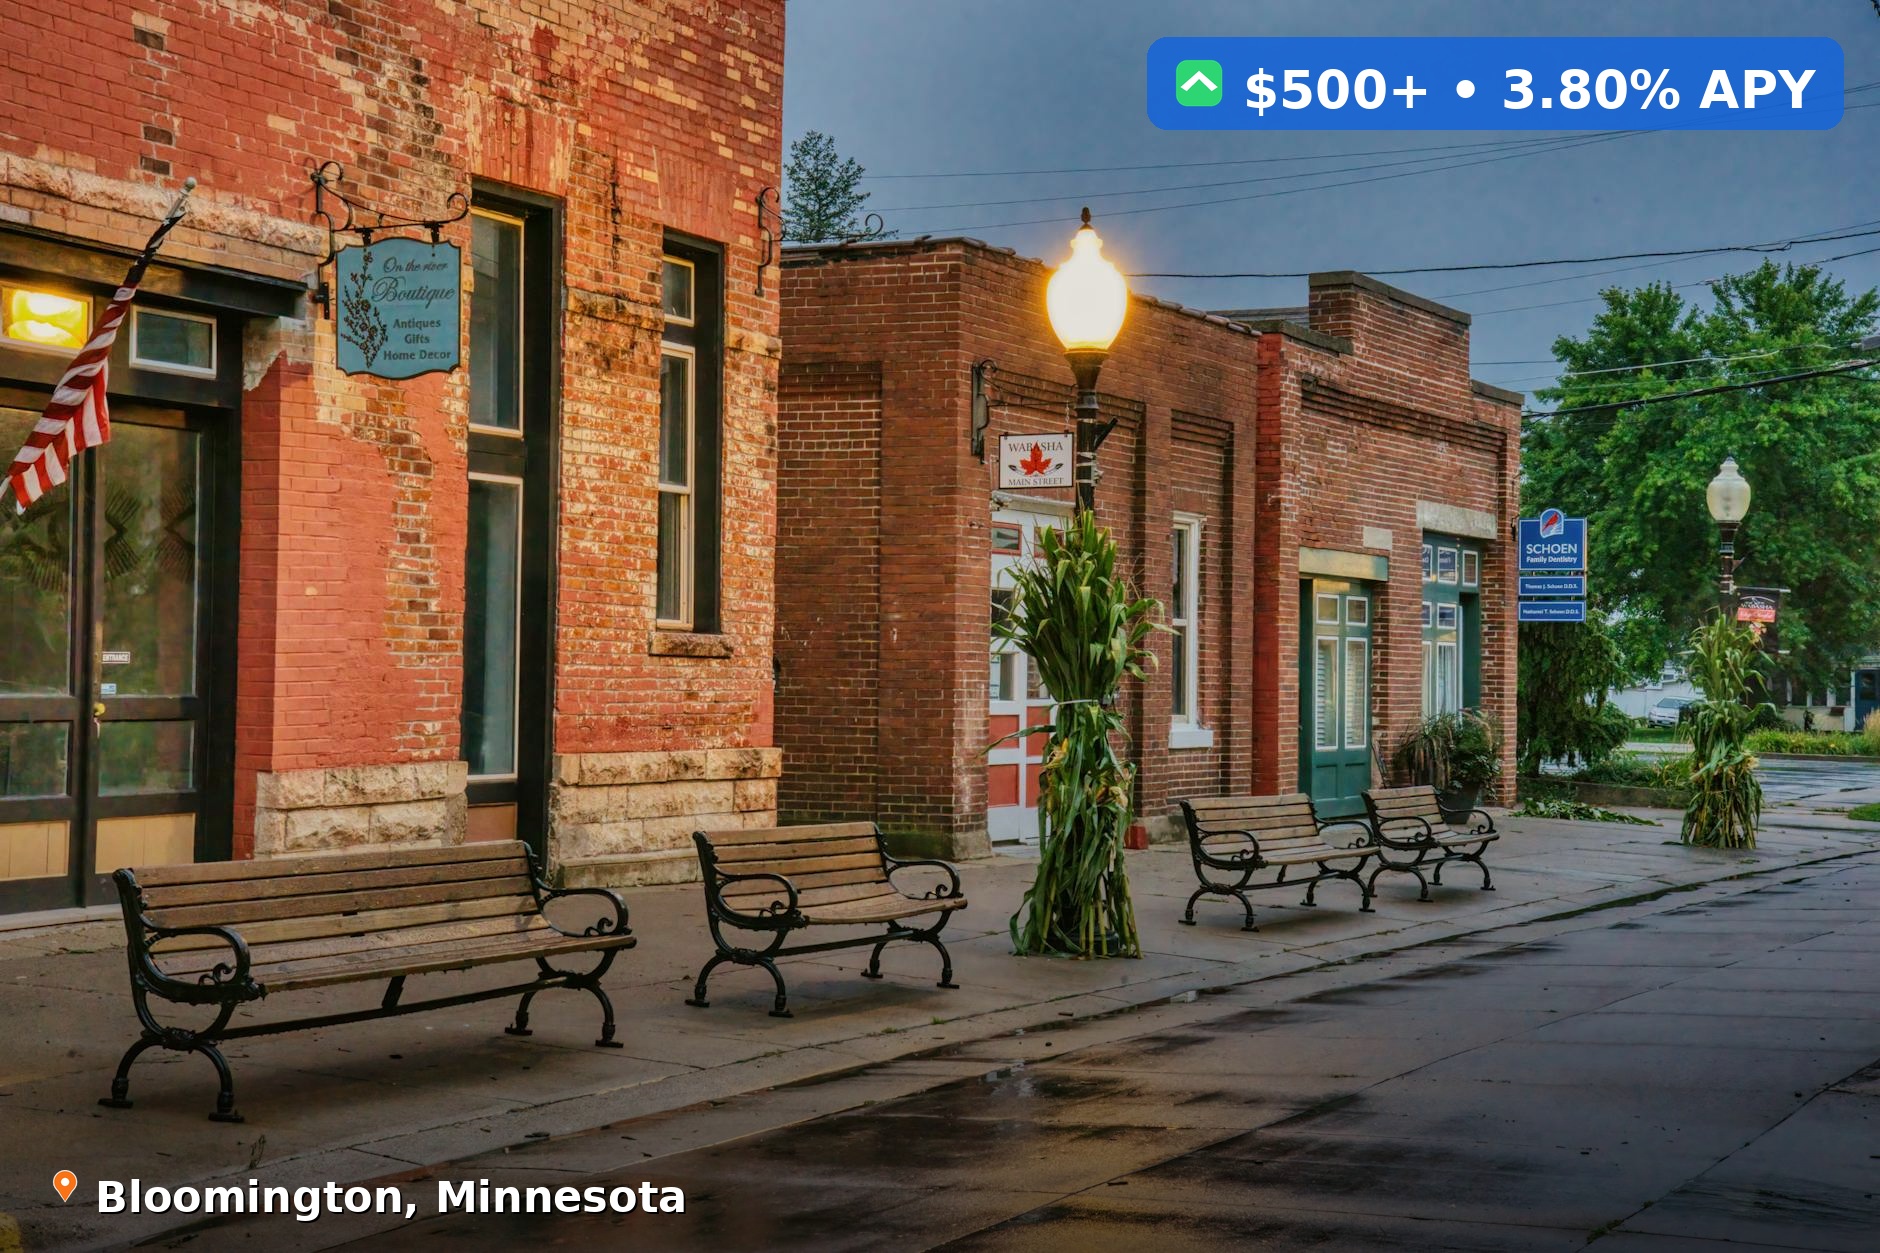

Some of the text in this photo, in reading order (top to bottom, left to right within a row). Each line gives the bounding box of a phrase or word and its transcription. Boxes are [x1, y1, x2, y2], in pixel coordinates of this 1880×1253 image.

[383, 256, 448, 273] On the river
[371, 276, 455, 309] Boutique
[393, 318, 441, 331] Antiques
[404, 333, 430, 344] Gifts
[383, 349, 452, 361] Home Decor
[1008, 477, 1064, 487] MAIN STREET
[1526, 543, 1578, 555] SCHOEN
[1526, 556, 1578, 564] Family Dentistry
